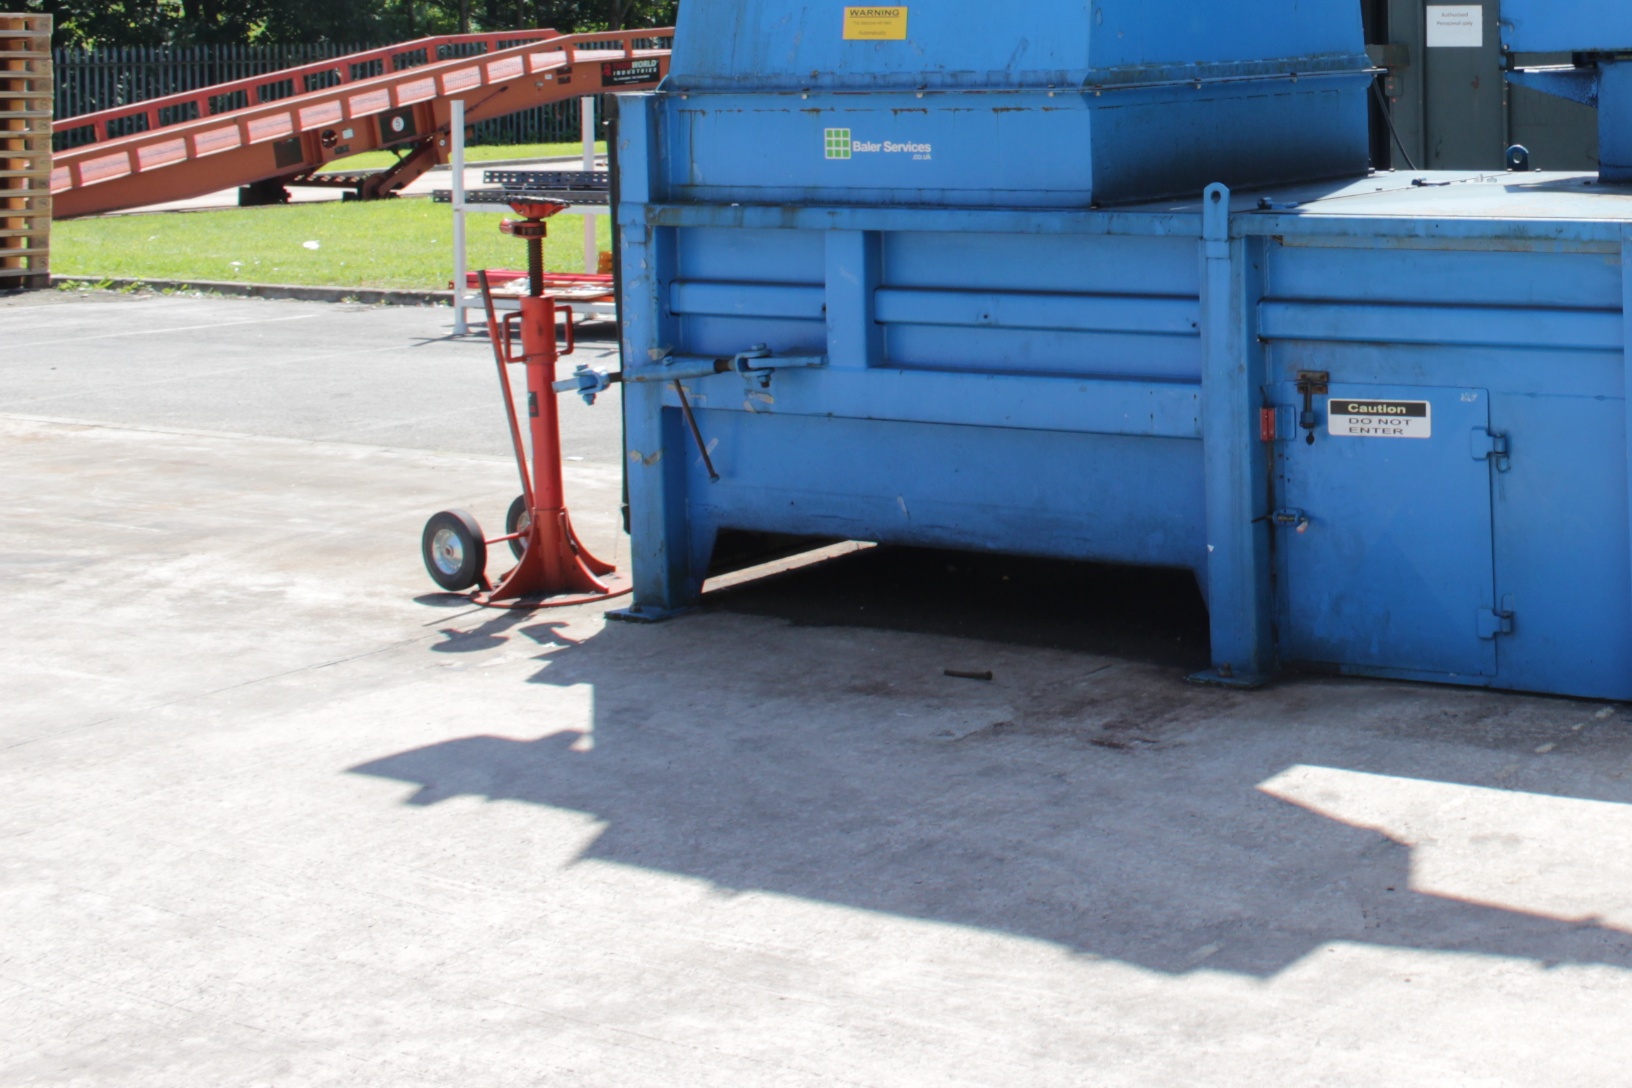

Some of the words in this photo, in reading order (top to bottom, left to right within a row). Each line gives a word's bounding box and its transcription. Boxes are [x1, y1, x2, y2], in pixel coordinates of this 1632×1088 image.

[852, 141, 882, 152] Baler
[883, 141, 932, 152] Services
[1347, 403, 1406, 414] Caution
[1378, 418, 1412, 426] NOT
[1349, 427, 1404, 435] ENTER
